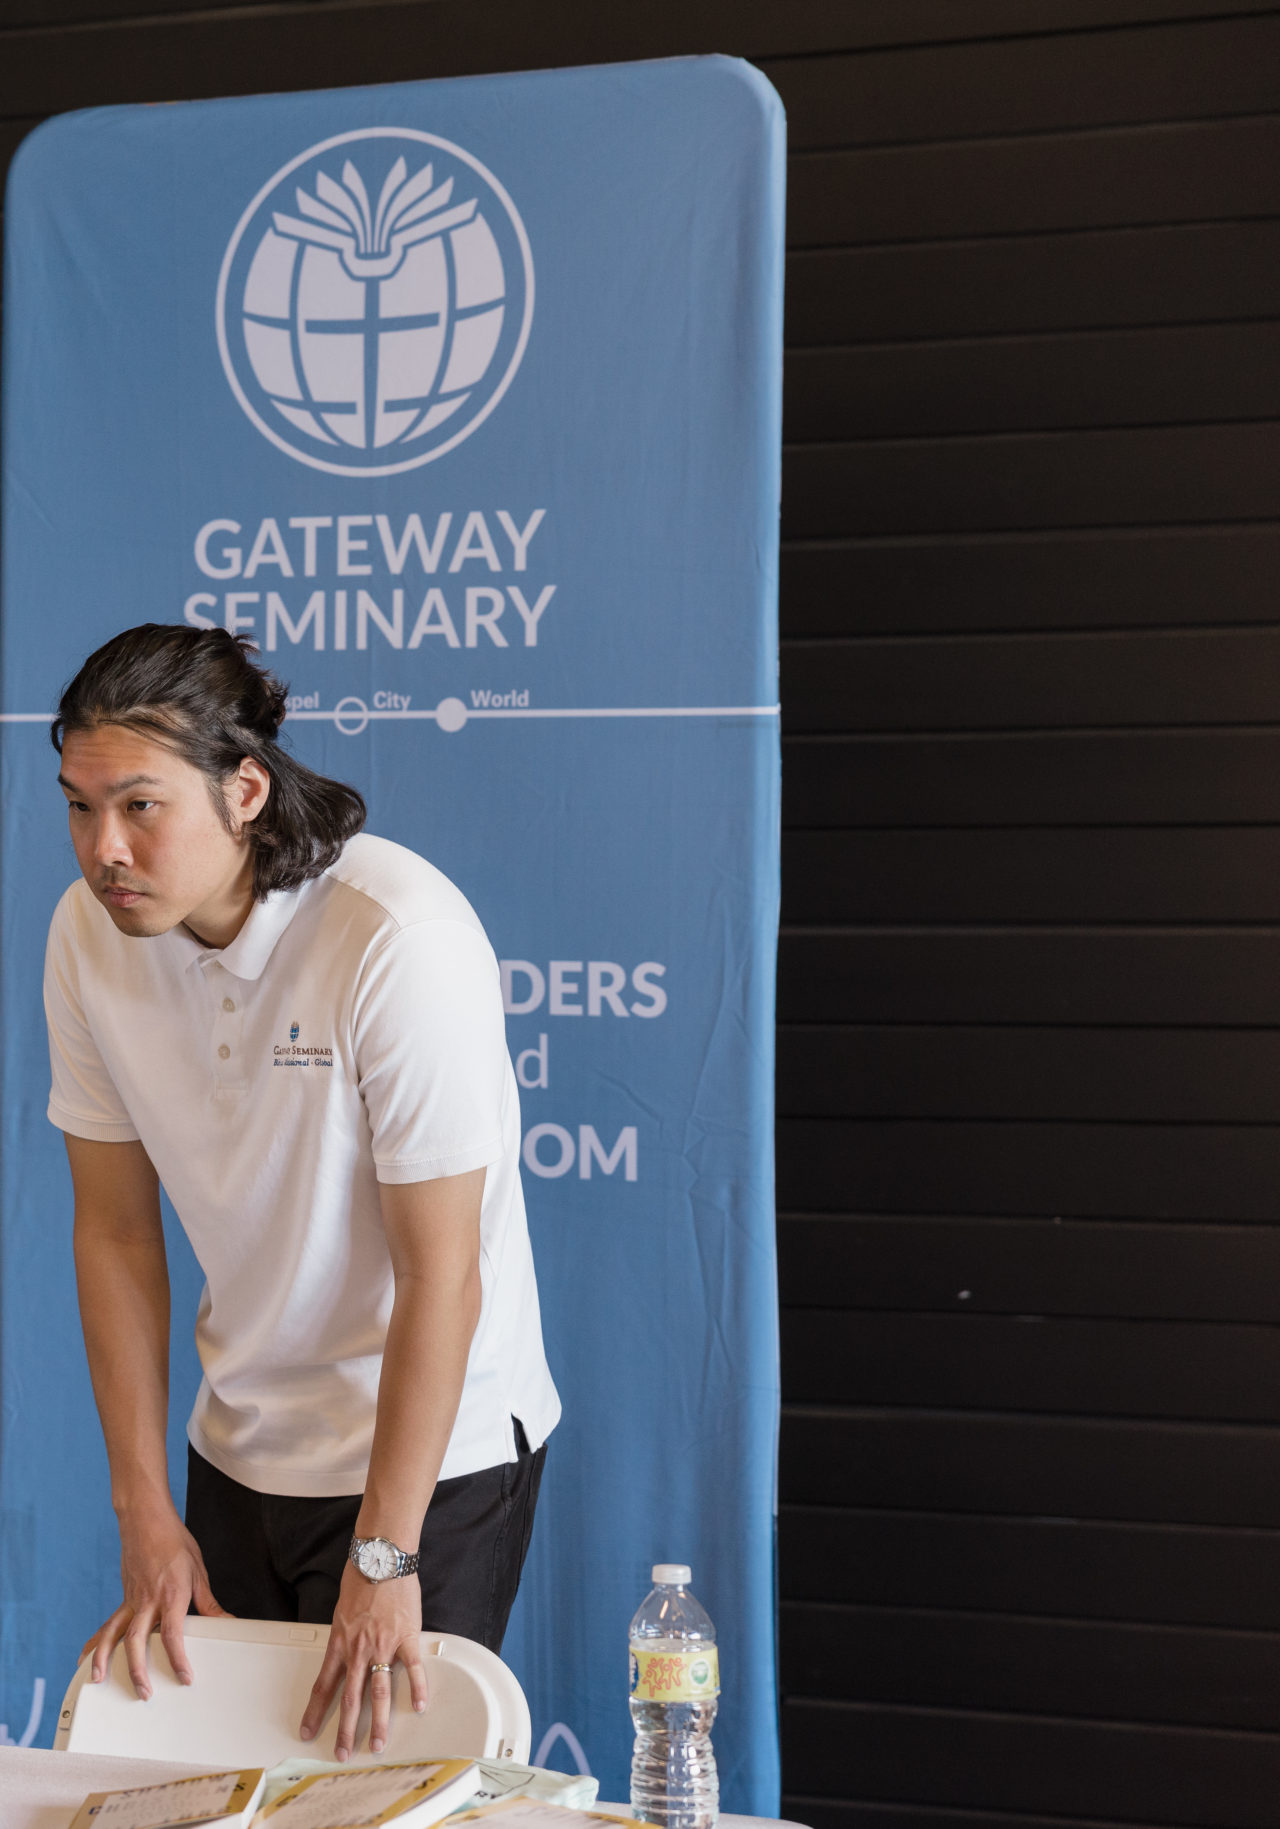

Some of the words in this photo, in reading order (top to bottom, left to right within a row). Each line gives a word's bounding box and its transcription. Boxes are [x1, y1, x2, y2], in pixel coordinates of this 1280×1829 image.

[194, 508, 546, 580] GATEWAY
[183, 585, 557, 652] SEMINARY
[283, 690, 320, 712] spel
[373, 690, 412, 711] City
[471, 689, 530, 707] World
[499, 959, 668, 1019] DERS
